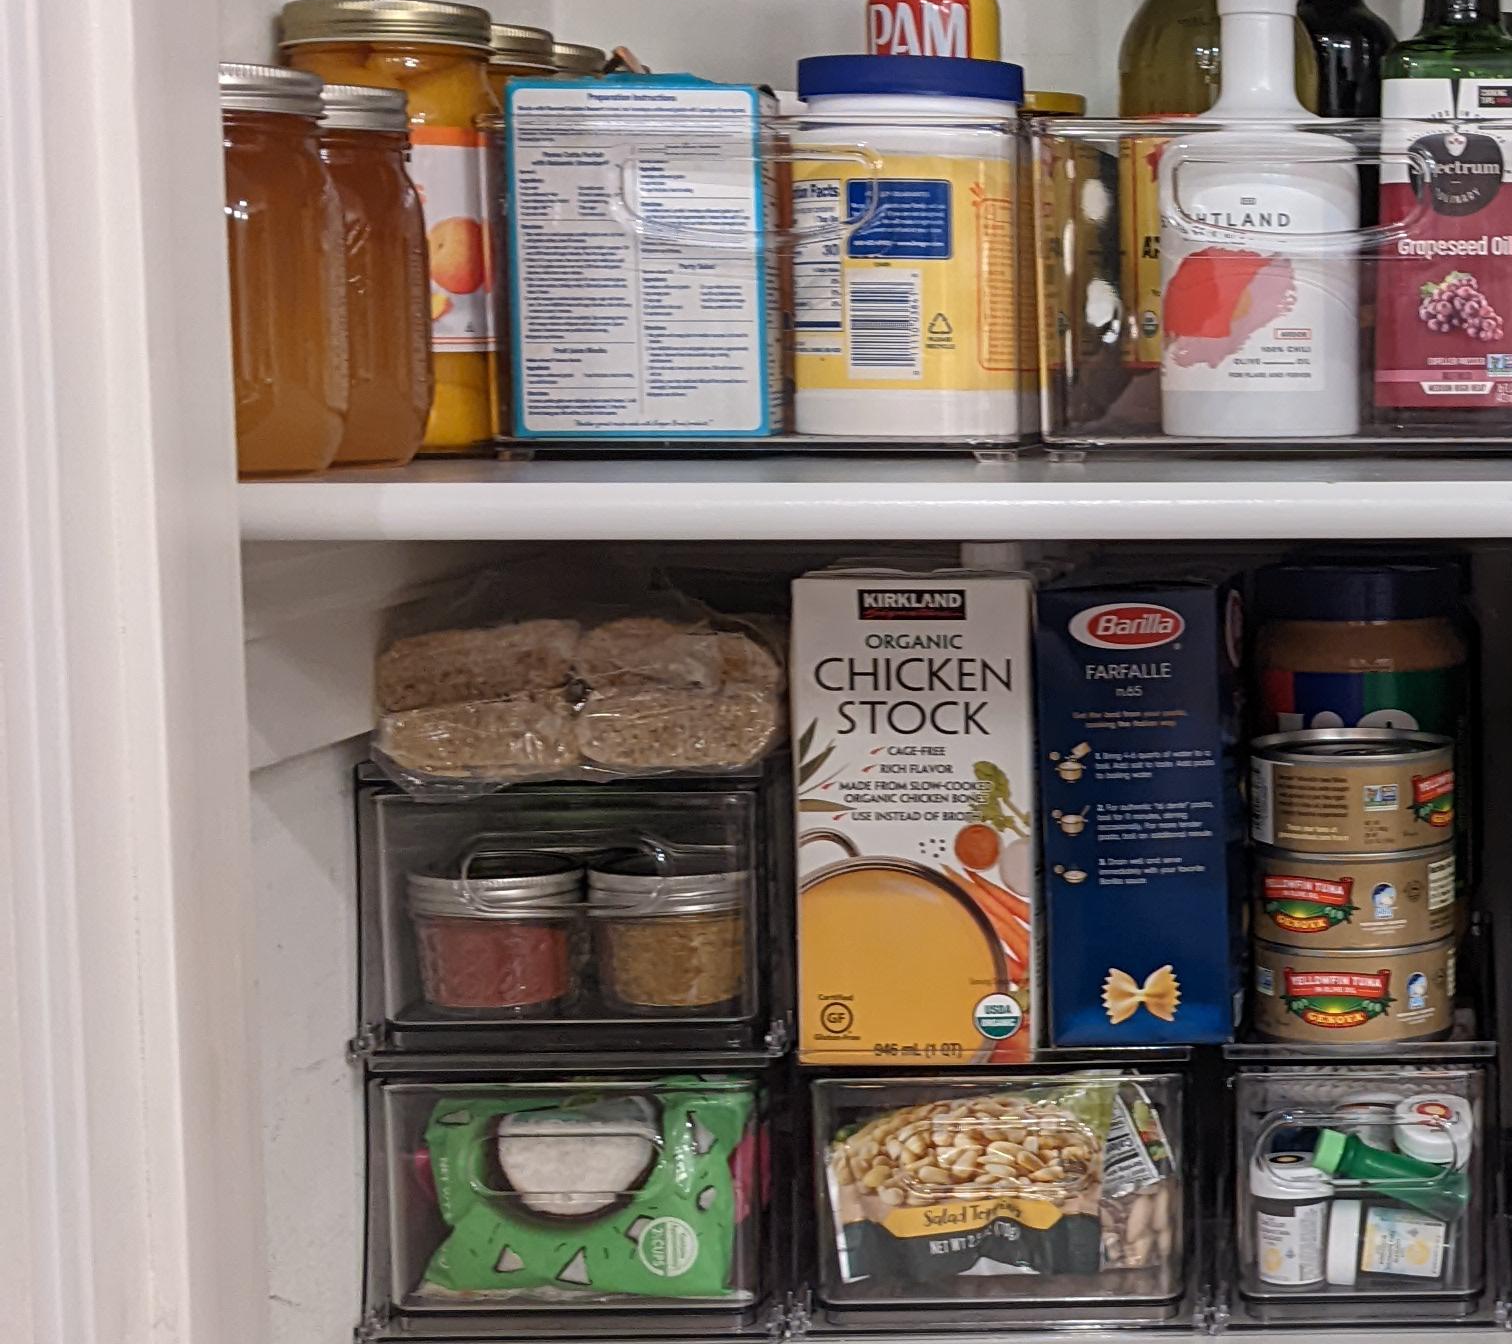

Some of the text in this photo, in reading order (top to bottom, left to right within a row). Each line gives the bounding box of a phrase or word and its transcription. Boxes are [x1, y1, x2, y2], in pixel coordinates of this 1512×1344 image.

[868, 1, 969, 59] PAM
[1397, 236, 1489, 261] Grapeseed
[862, 591, 962, 610] KIRKLAND
[1097, 613, 1173, 637] Barilla
[865, 633, 963, 650] ORGANIC
[814, 657, 1013, 693] CHICKEN
[1085, 662, 1172, 680] FARFALLE
[837, 700, 991, 736] STOCK
[887, 746, 947, 756] CAGE-FREE
[879, 764, 954, 774] RICH FLAVOR
[839, 781, 872, 791] MADE
[874, 781, 907, 791] FROM
[843, 793, 949, 804] ORGANIC CHICKEN
[851, 811, 940, 821] USE INSTEAD OF
[1352, 975, 1382, 987] TUNA
[983, 1004, 1012, 1014] USDA
[826, 1012, 847, 1024] GF
[923, 1206, 967, 1228] Salad
